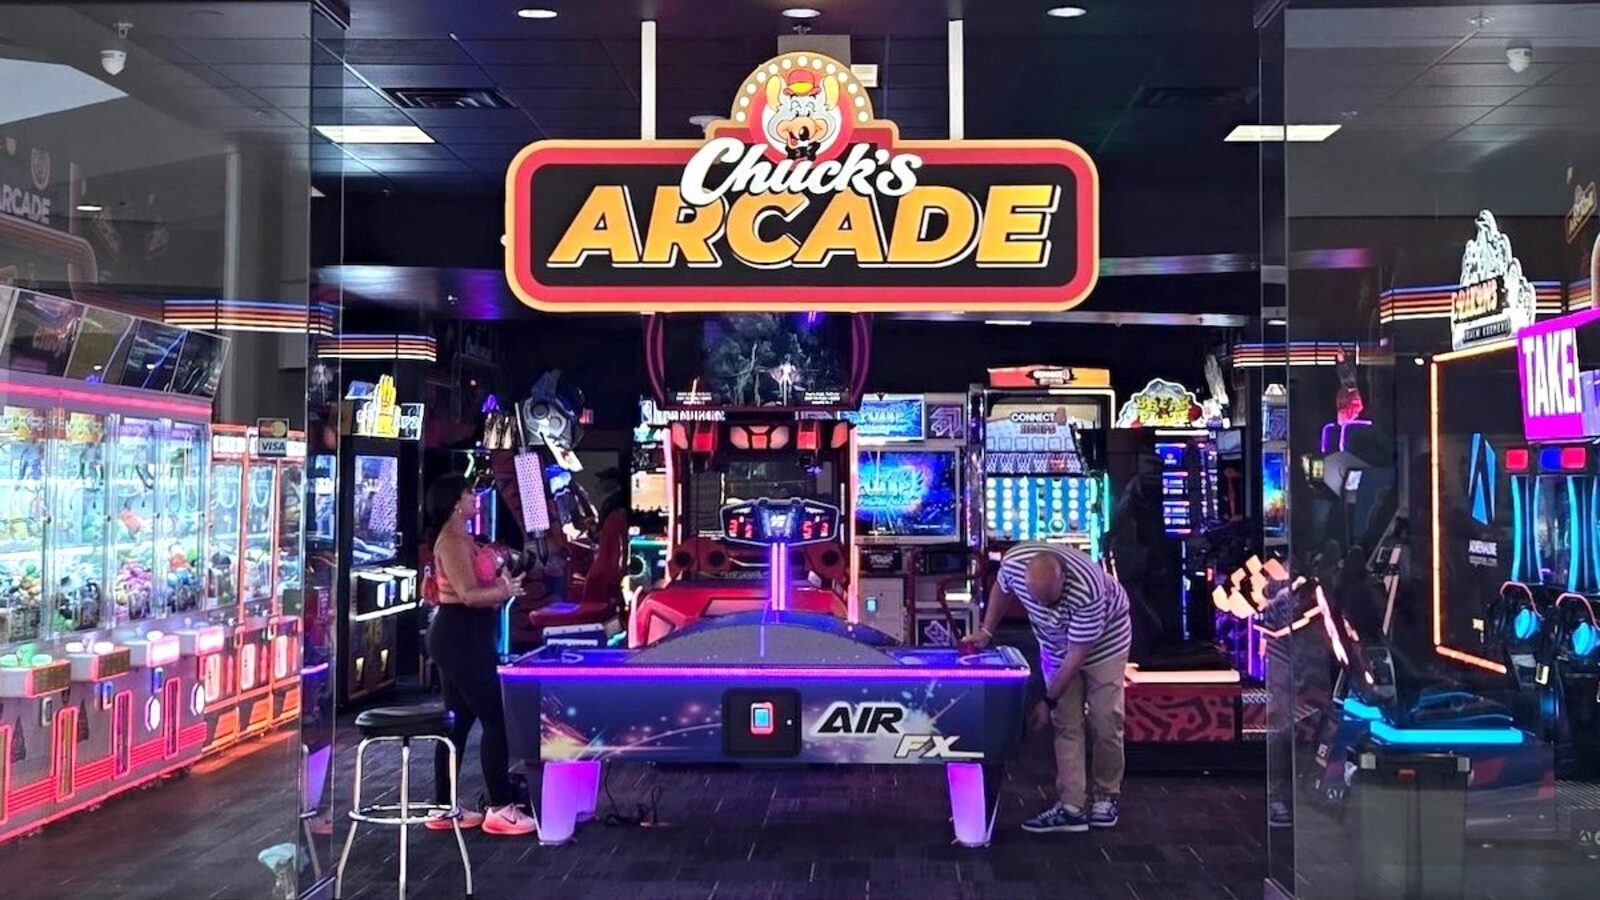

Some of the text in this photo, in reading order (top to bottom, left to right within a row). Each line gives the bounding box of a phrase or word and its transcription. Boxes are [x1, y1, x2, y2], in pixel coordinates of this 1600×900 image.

[680, 136, 922, 207] Chuck's
[0, 183, 51, 226] RCADE
[546, 185, 1061, 269] ARCADE
[1011, 412, 1056, 423] CONNECT
[261, 442, 287, 452] VISA
[816, 704, 906, 735] AIR
[895, 734, 984, 759] FX
